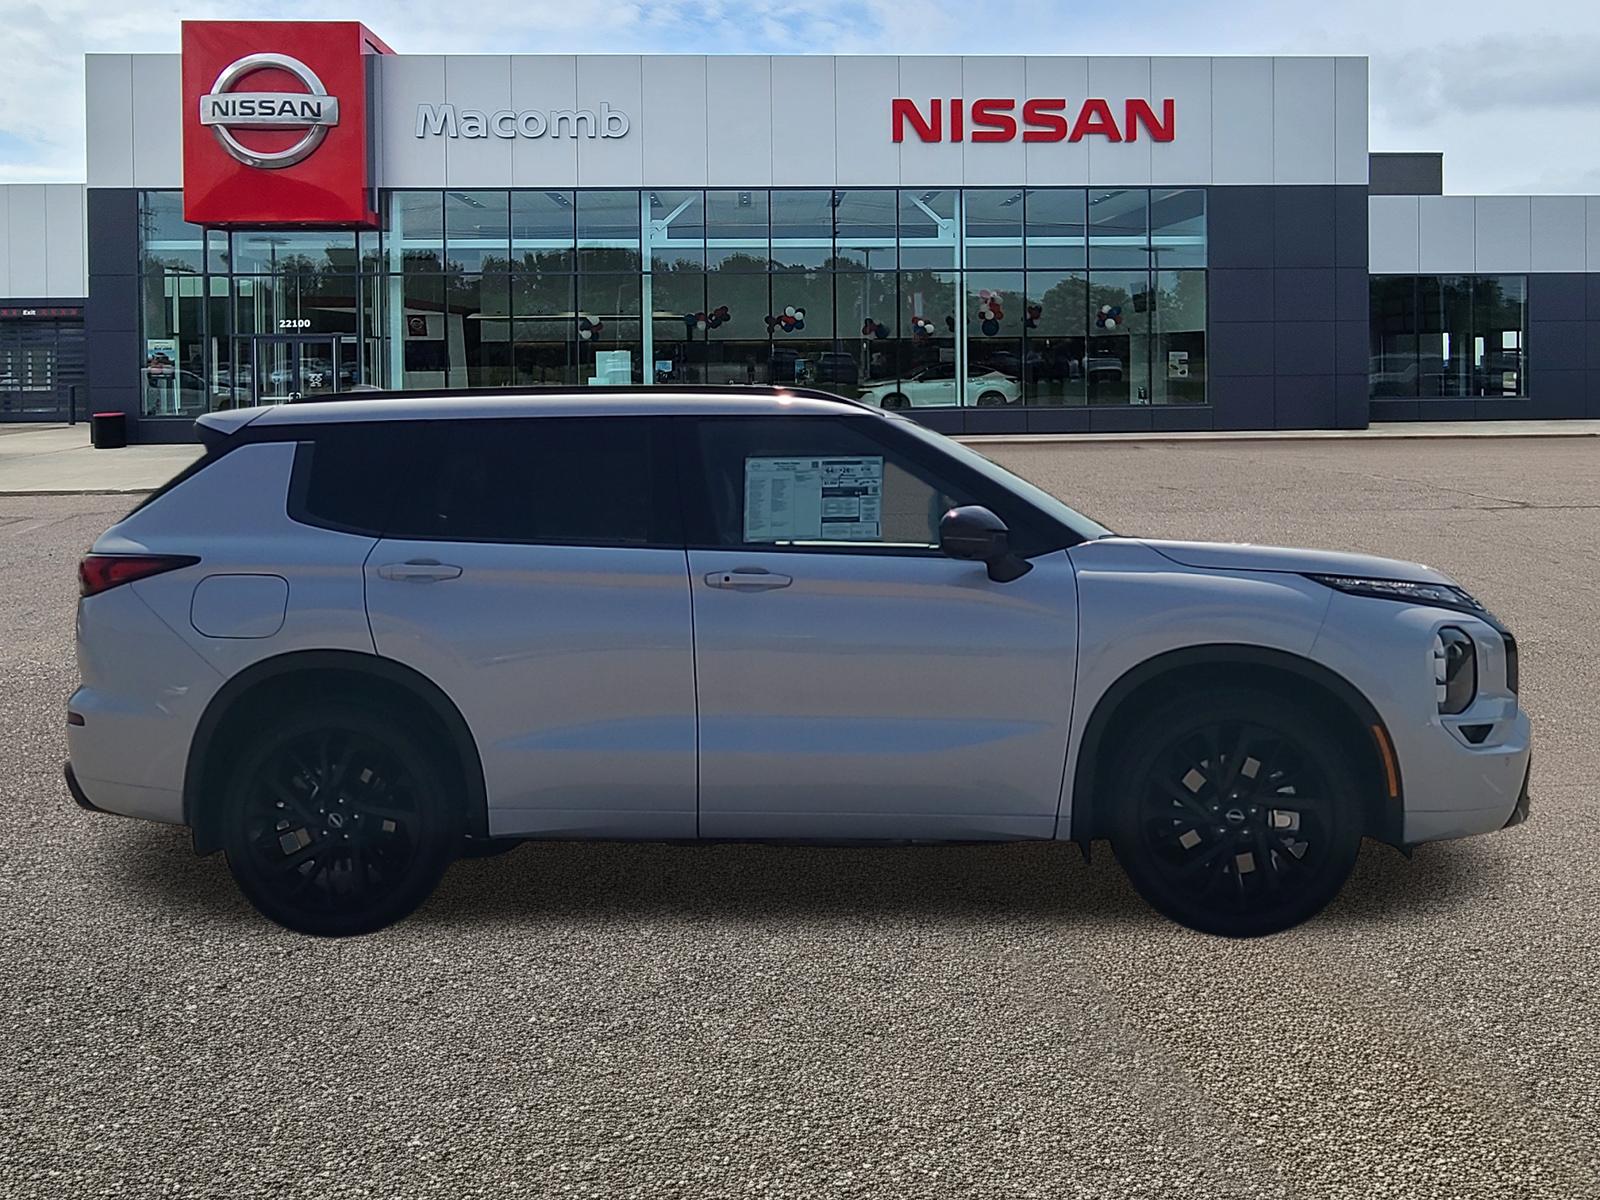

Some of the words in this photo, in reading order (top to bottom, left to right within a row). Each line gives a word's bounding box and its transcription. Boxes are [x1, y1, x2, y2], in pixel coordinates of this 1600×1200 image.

[211, 99, 322, 118] NISSAN
[415, 102, 630, 139] Macomb
[892, 98, 1176, 143] NISSAN
[279, 319, 311, 328] 22100
